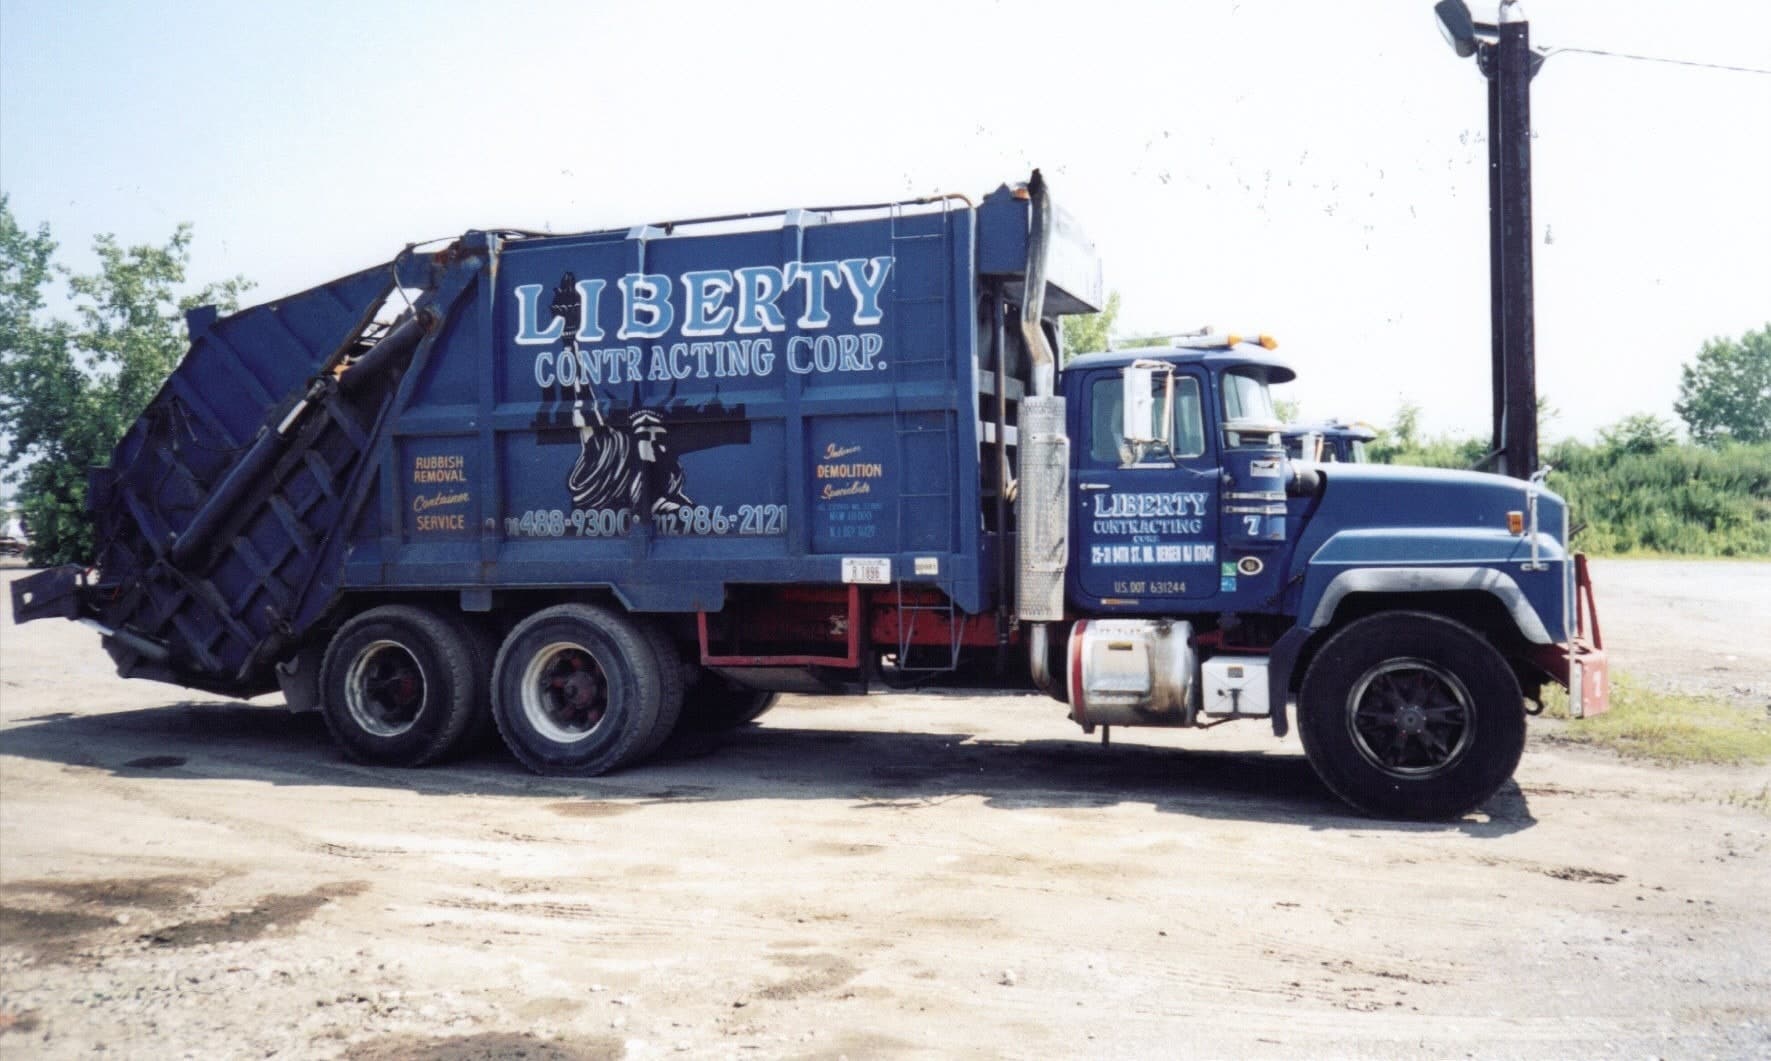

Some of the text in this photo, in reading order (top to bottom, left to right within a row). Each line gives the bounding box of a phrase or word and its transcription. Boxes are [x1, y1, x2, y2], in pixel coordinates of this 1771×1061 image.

[514, 255, 895, 345] LIBERTY
[535, 333, 888, 388] CONTRACTING CORP.
[415, 455, 464, 470] RUBBISH
[816, 463, 883, 478] DEMOLITION
[414, 469, 467, 484] REMOVAL
[1093, 492, 1209, 518] LIBERTY
[416, 514, 465, 530] SERVICE
[678, 503, 788, 536] 986-2121
[1093, 518, 1202, 535] CONTRACTING
[1243, 514, 1262, 536] 7
